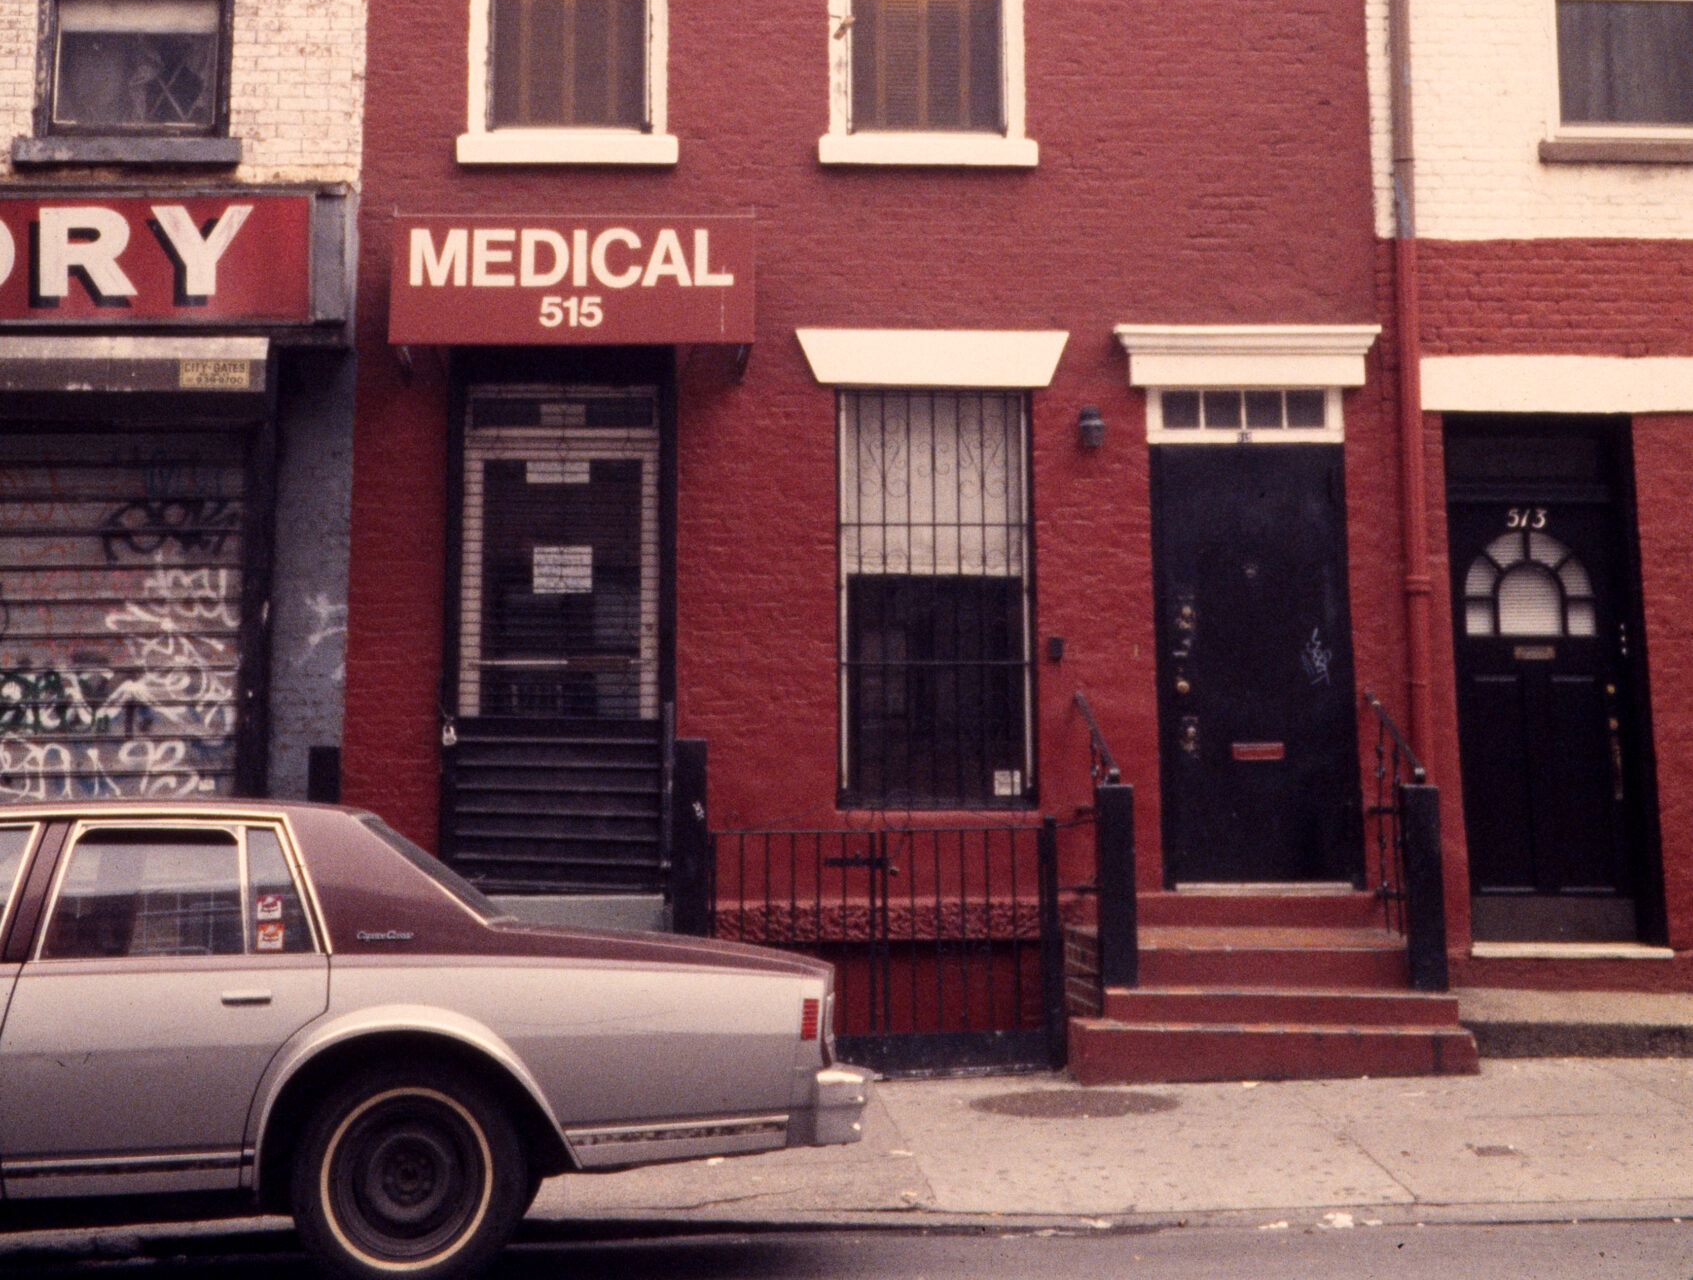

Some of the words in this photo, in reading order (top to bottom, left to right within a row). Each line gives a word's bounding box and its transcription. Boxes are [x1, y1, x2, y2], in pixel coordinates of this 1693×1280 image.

[0, 204, 254, 298] RY
[409, 228, 734, 289] MEDICAL
[538, 296, 603, 328] 515
[1507, 508, 1547, 528] 513
